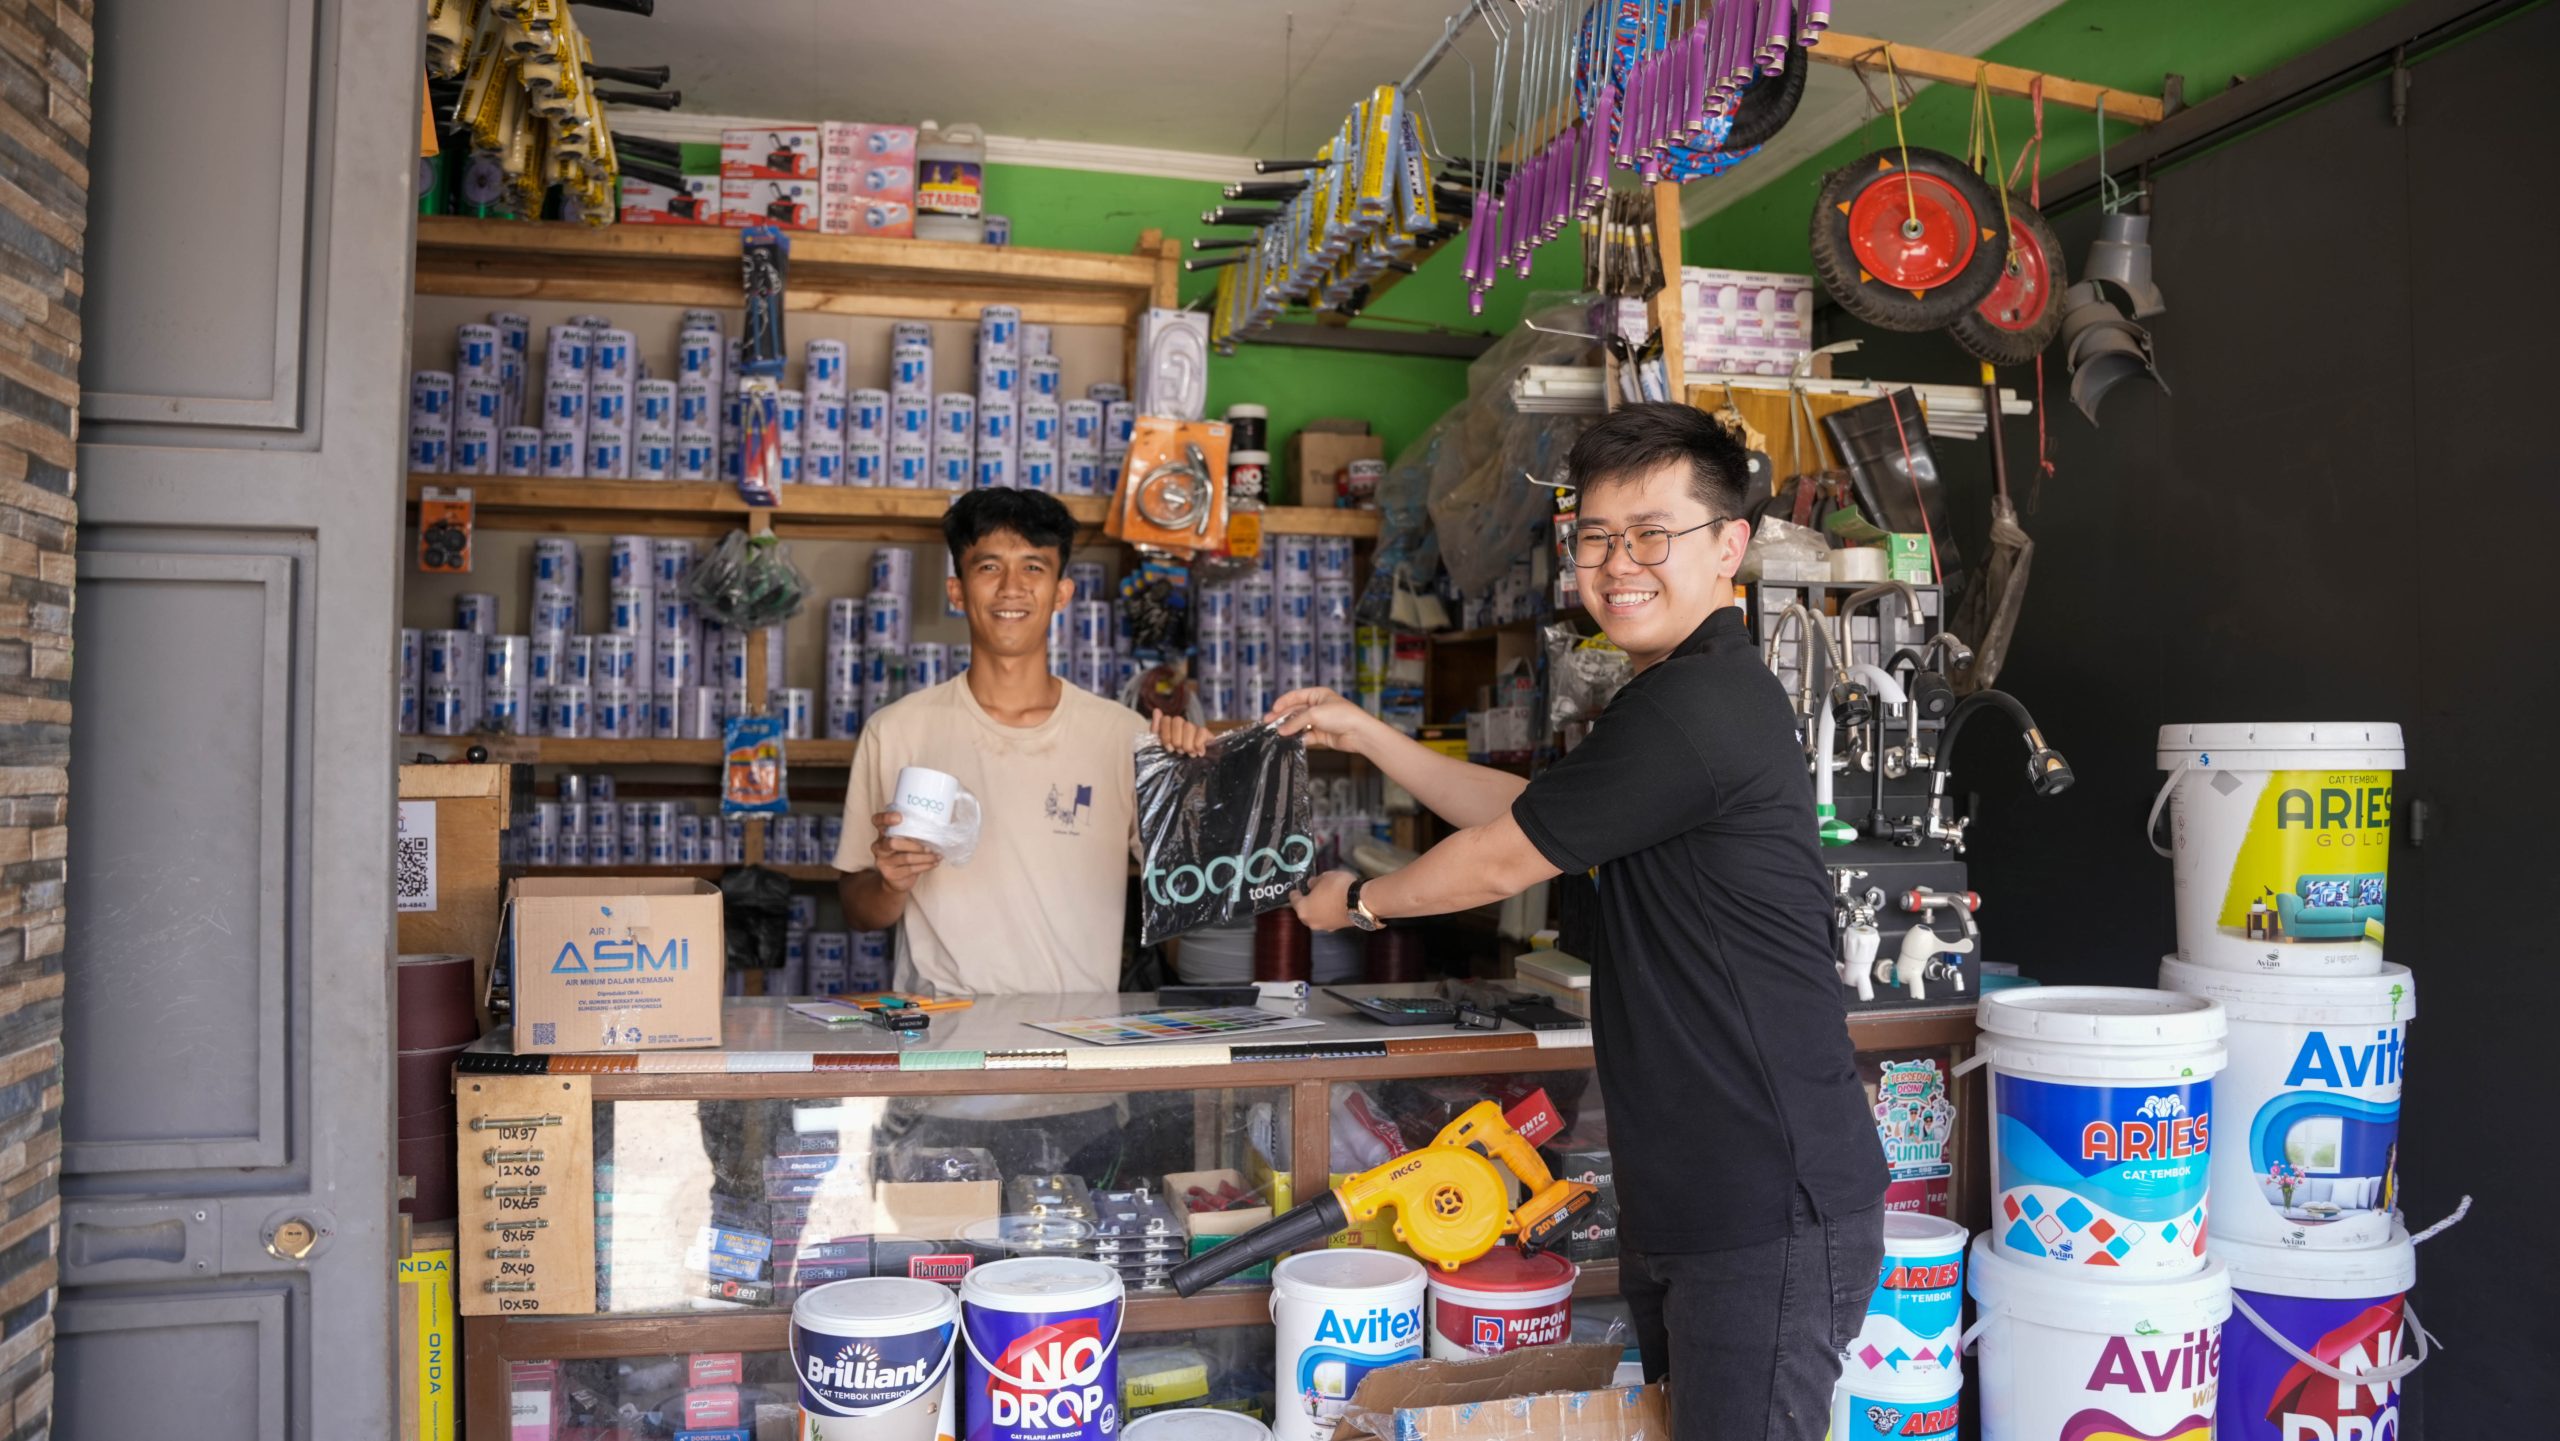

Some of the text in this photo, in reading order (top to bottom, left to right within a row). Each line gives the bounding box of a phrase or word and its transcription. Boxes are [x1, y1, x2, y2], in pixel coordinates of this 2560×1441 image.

[2328, 775, 2379, 784] CAT TEMBOK
[2316, 833, 2384, 847] GOLD
[2256, 959, 2281, 968] Avian
[580, 978, 606, 986] MINUM
[607, 977, 635, 985] DALAM
[636, 976, 674, 985] KEMASAN
[1890, 1072, 1932, 1083] TERSEDIA
[1897, 1083, 1924, 1094] DISINI
[1515, 1112, 1547, 1135] ENTO
[2082, 1113, 2209, 1162] ARIES
[2122, 1166, 2191, 1180] CAT TEMBOK
[2280, 1236, 2306, 1246] Avian
[2049, 1247, 2074, 1259] Avian
[400, 1260, 447, 1273] NDA
[914, 1260, 969, 1278] Harmoni
[1883, 1261, 1960, 1291] ARIES
[1911, 1292, 1951, 1303] TEMBOK
[1314, 1305, 1420, 1344] Avitex
[1508, 1310, 1566, 1332] NIPPON
[1517, 1326, 1562, 1345] PAINT
[429, 1333, 442, 1394] ONDA
[1021, 1336, 1103, 1389] NO
[2085, 1329, 2221, 1393] Avite
[807, 1355, 927, 1389] Brilliant
[819, 1389, 832, 1397] CAT
[834, 1391, 869, 1401] TEMBOK
[992, 1385, 1104, 1429] DROP
[1899, 1403, 1959, 1436] ARIE
[1047, 1433, 1061, 1441] ANTI
